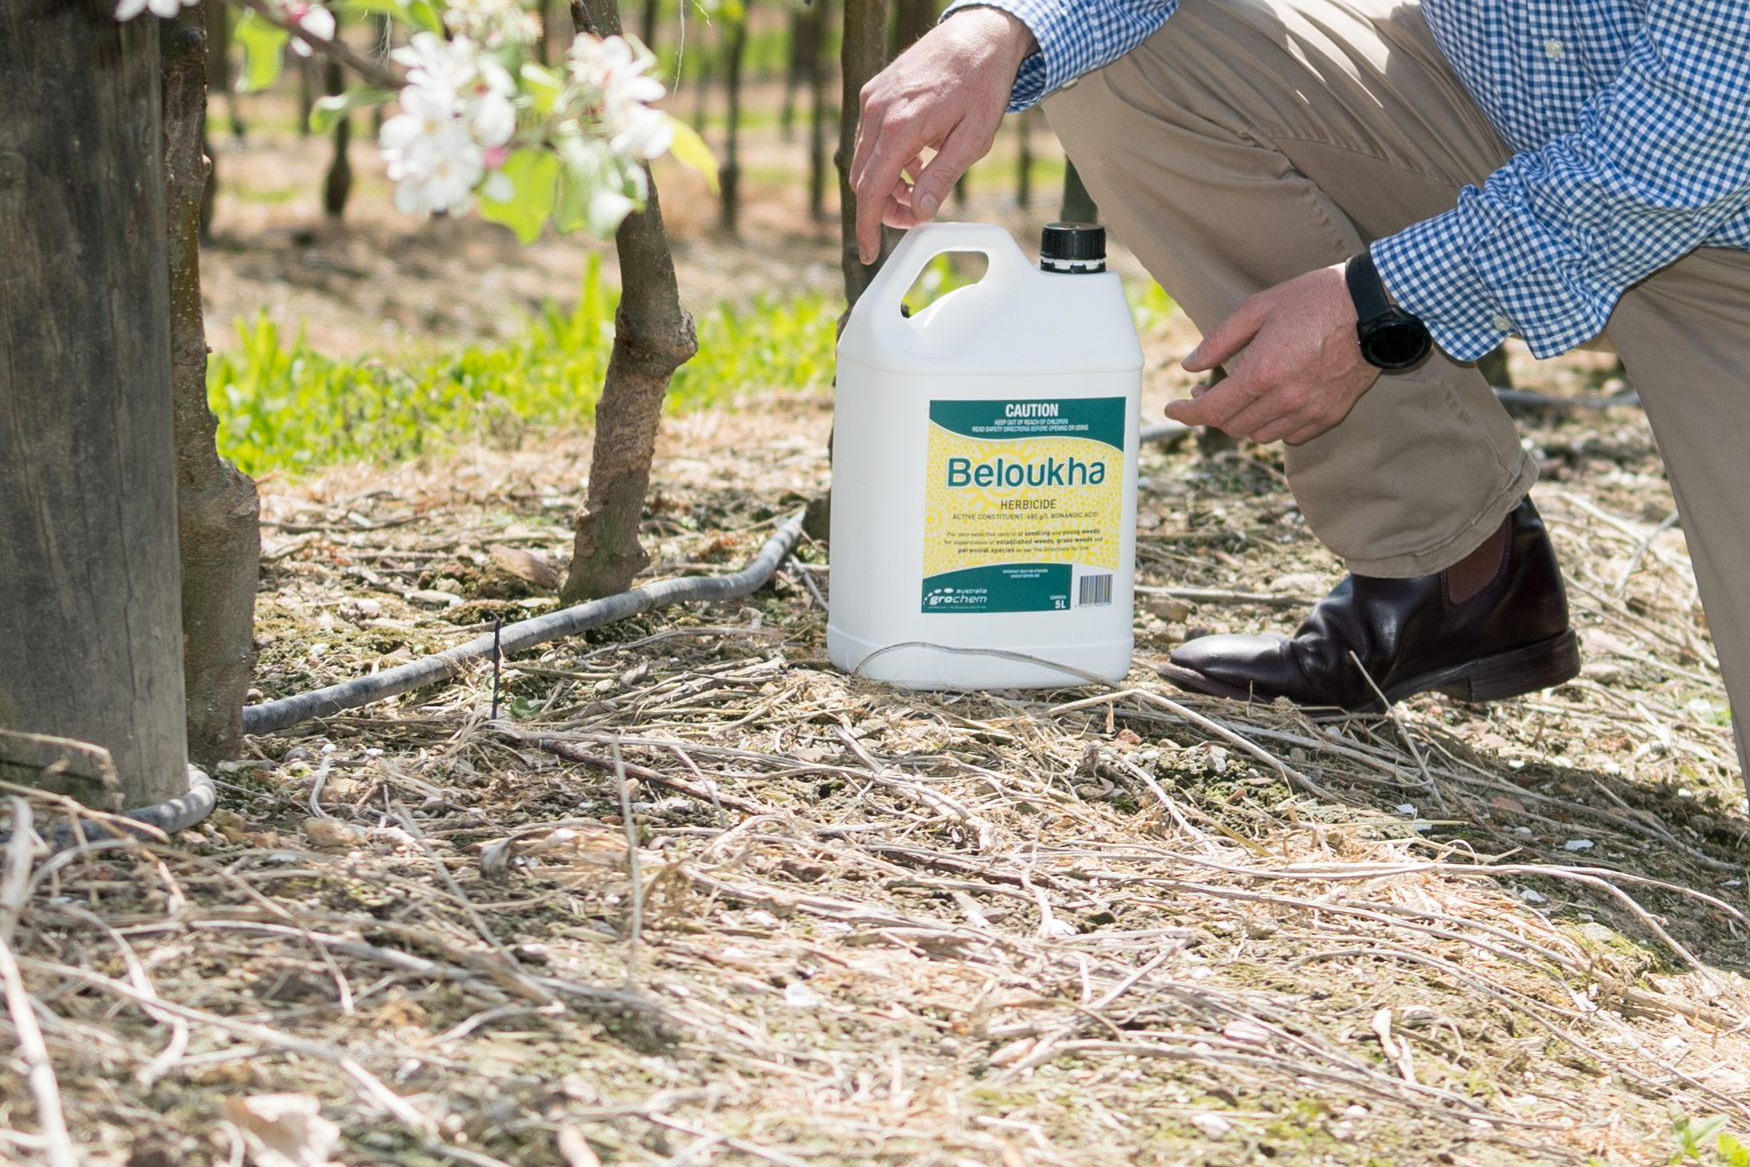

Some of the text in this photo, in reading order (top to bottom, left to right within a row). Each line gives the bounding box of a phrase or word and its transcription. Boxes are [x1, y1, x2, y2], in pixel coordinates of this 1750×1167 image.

[1005, 403, 1059, 417] CAUTION
[947, 457, 1105, 487] Beloukha
[1000, 499, 1057, 510] HERBICIDE
[929, 594, 988, 606] grochem
